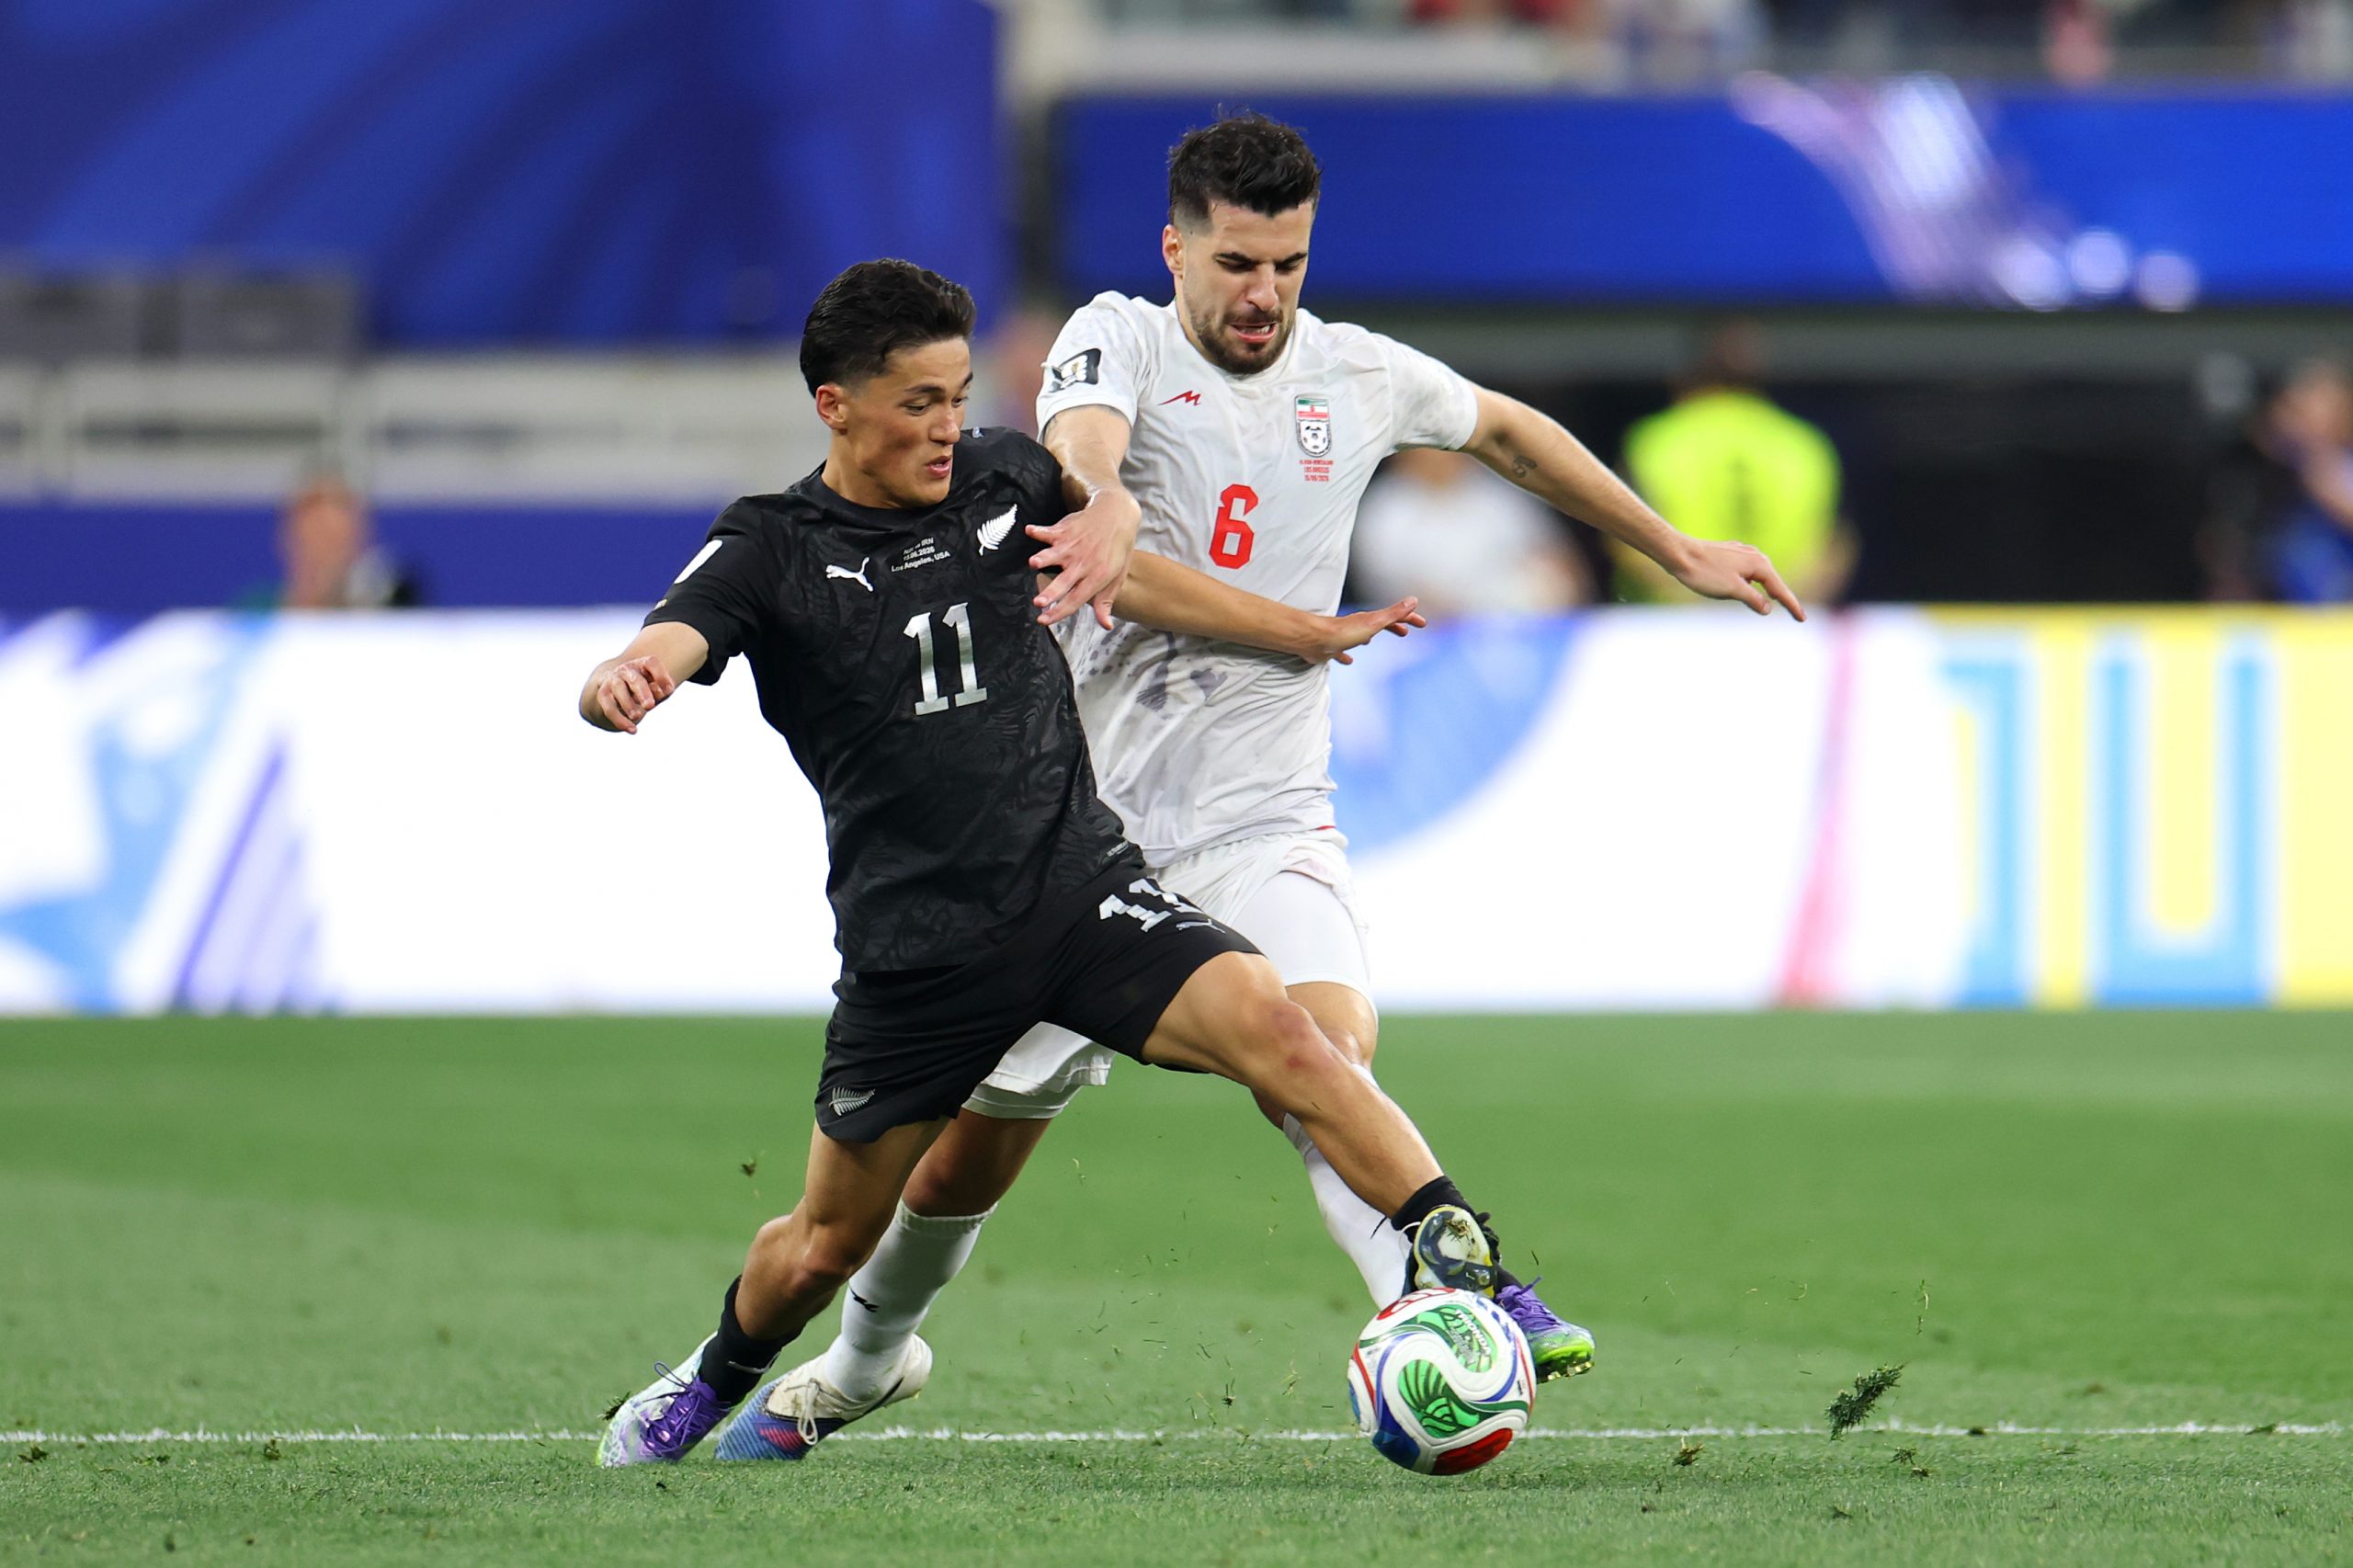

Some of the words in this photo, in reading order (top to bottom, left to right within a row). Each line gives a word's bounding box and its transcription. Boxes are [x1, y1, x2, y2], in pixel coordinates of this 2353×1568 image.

[1209, 483, 1258, 569] 6
[904, 556, 935, 570] Angeles,
[934, 551, 950, 561] USA
[903, 602, 988, 715] 11
[1455, 1309, 1491, 1356] TRIONDA
